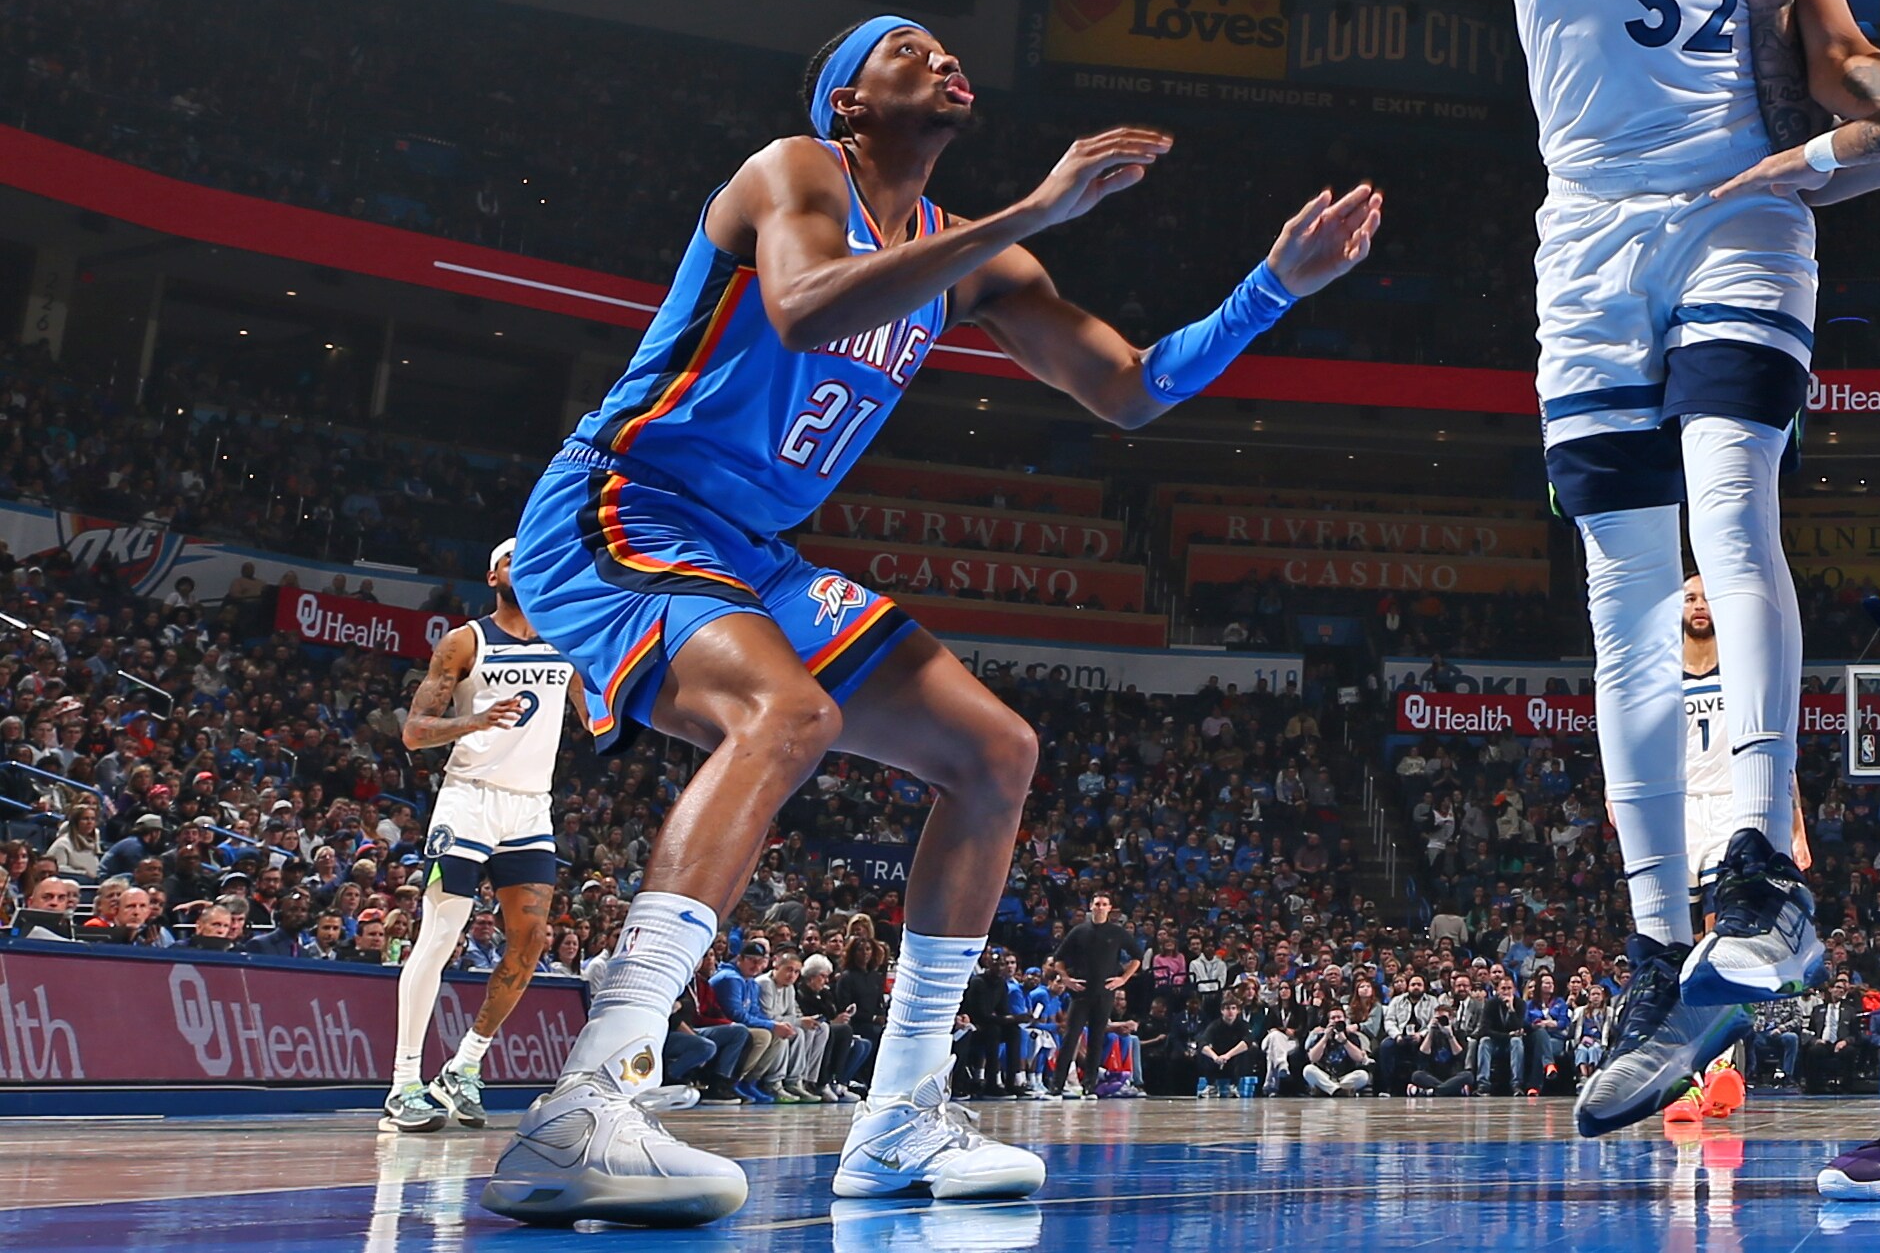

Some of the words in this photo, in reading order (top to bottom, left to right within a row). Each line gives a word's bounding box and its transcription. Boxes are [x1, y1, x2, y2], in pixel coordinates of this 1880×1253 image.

[1025, 14, 1043, 69] 329
[1300, 3, 1409, 71] LOUD
[1424, 8, 1512, 85] CITY
[1075, 72, 1152, 94] BRING
[1161, 79, 1210, 99] THE
[1218, 85, 1335, 109] THUNDER
[1371, 97, 1427, 117] EXIT
[1433, 102, 1490, 123] NOW
[37, 272, 58, 331] 226
[778, 379, 883, 478] 21
[812, 502, 1110, 560] IVERWIND
[1227, 515, 1502, 552] RIVERWIND
[869, 553, 1081, 601] CASINO
[1284, 558, 1459, 591] CASINO
[296, 593, 323, 637] OU
[325, 613, 400, 653] Health
[482, 669, 567, 686] WOLVES
[513, 690, 540, 728] 9
[1405, 695, 1431, 729] OU
[1435, 705, 1512, 733] Health
[1557, 708, 1599, 733] Hea
[1684, 697, 1726, 717] OLVE
[1698, 718, 1710, 752] 1
[169, 963, 234, 1077] OU
[231, 999, 378, 1082] Health
